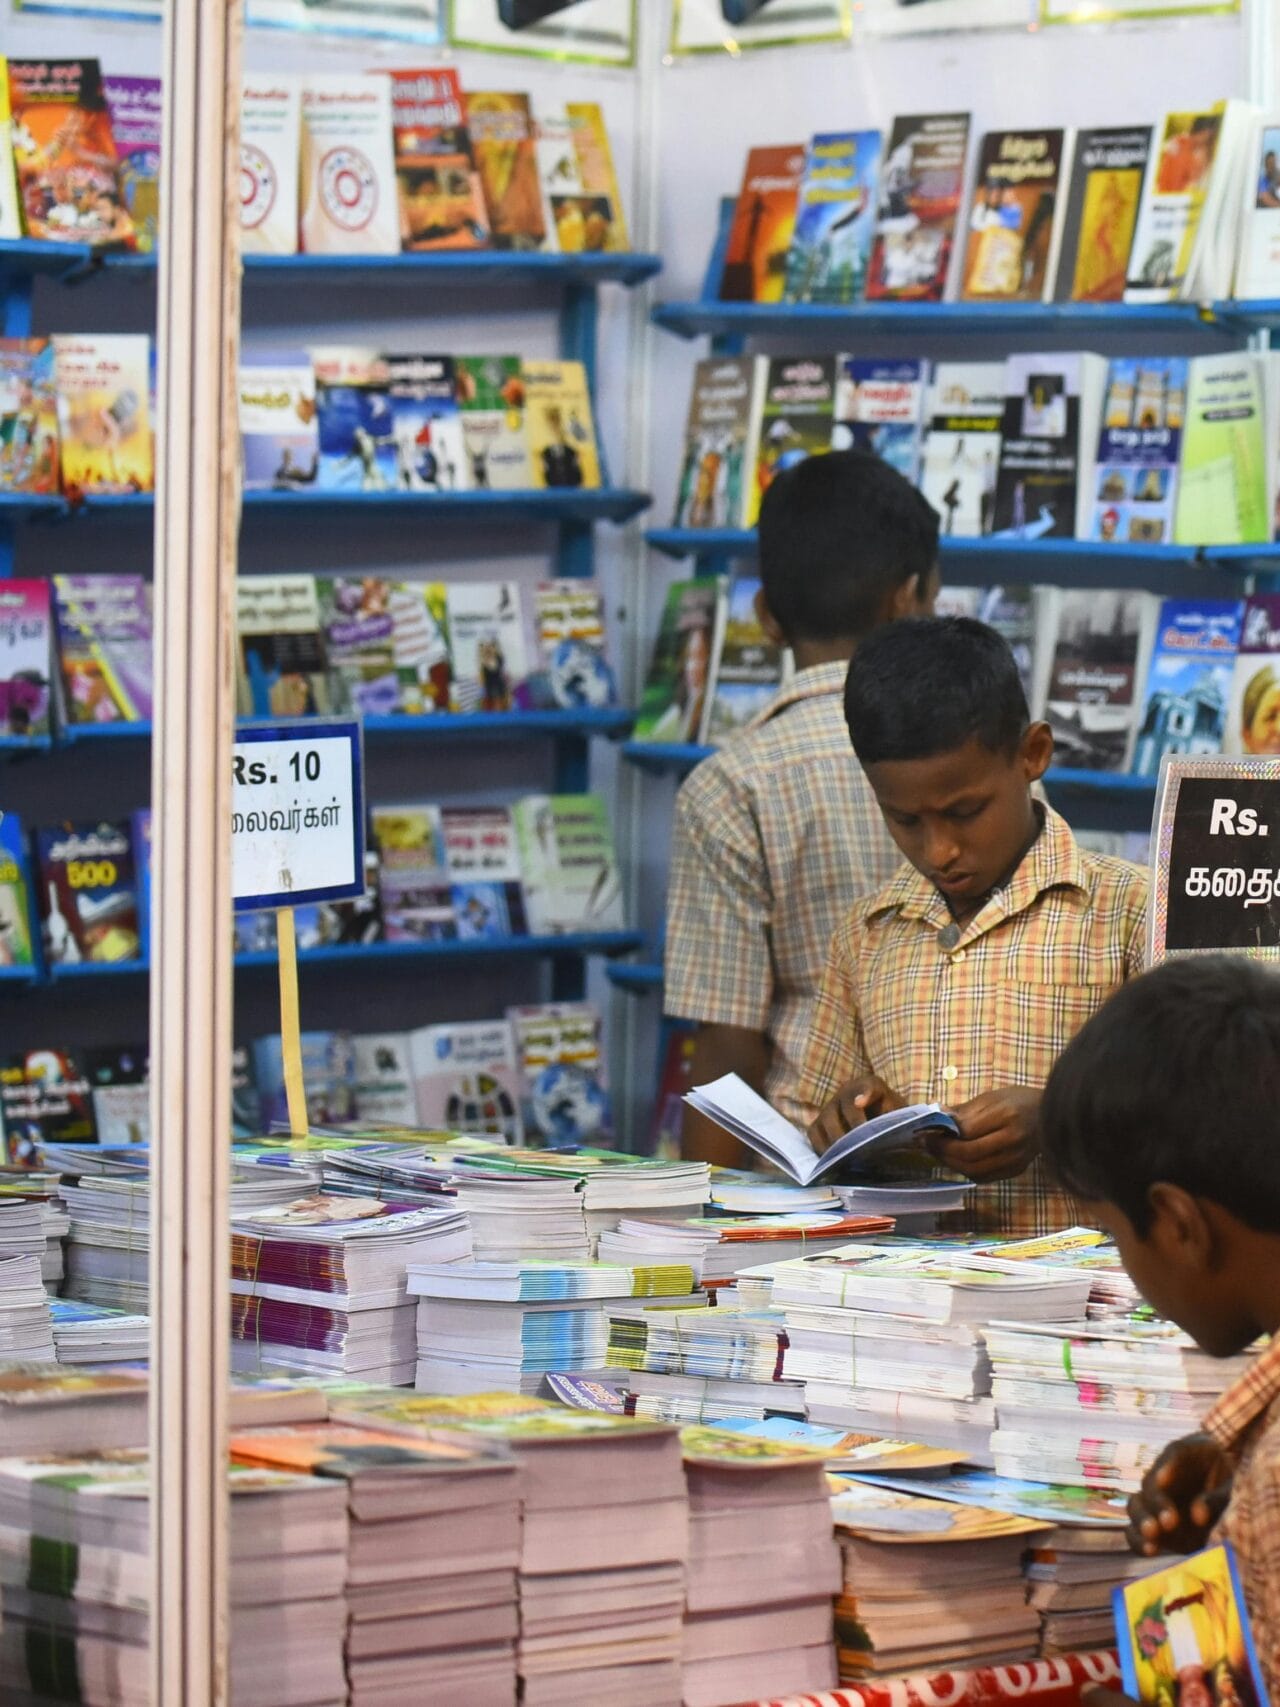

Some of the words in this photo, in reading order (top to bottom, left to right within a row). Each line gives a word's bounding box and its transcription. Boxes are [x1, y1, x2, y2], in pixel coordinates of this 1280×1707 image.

[232, 755, 278, 785] Rs.
[289, 750, 321, 782] 10
[232, 796, 341, 834] லைவர்கள்
[1209, 798, 1269, 836] Rs.
[67, 861, 117, 888] 500
